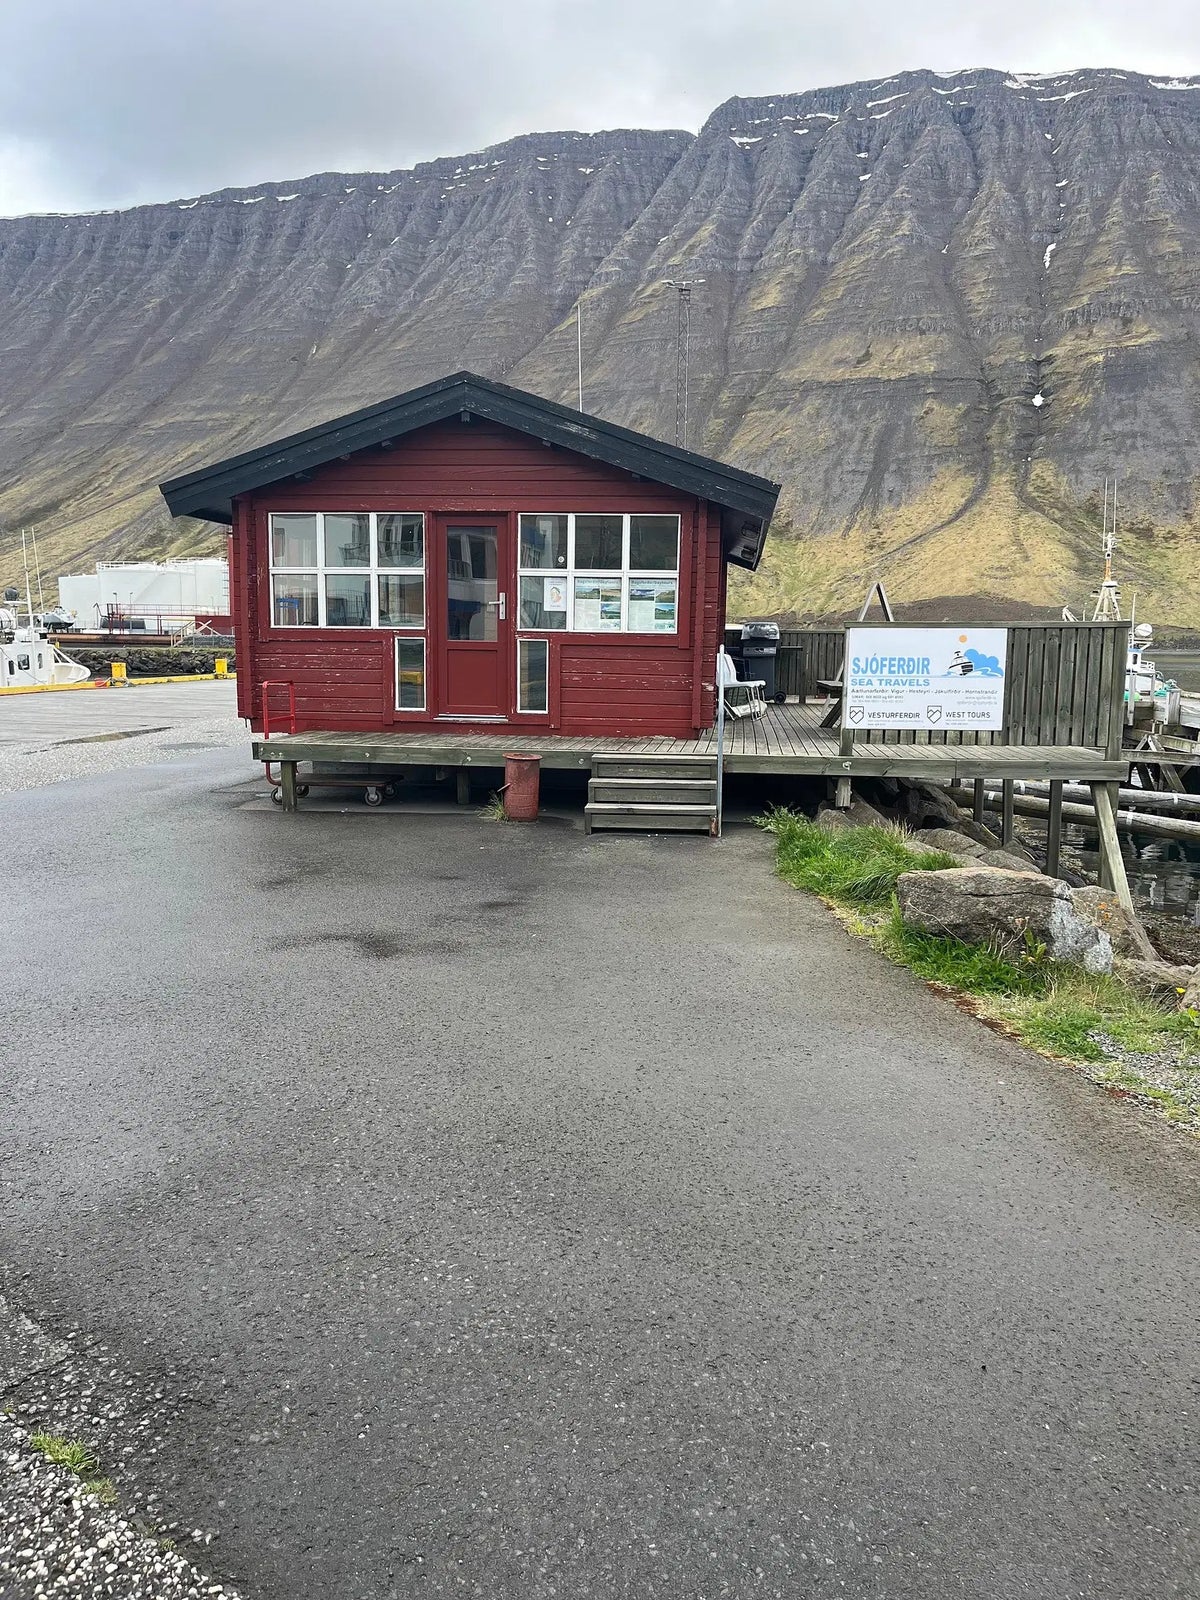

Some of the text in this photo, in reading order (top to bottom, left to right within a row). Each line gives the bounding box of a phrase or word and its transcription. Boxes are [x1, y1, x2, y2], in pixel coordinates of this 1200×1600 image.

[852, 653, 930, 675] SJÓFERÐIR
[851, 678, 930, 687] SEA TRAVELS
[967, 711, 991, 719] TOURS
